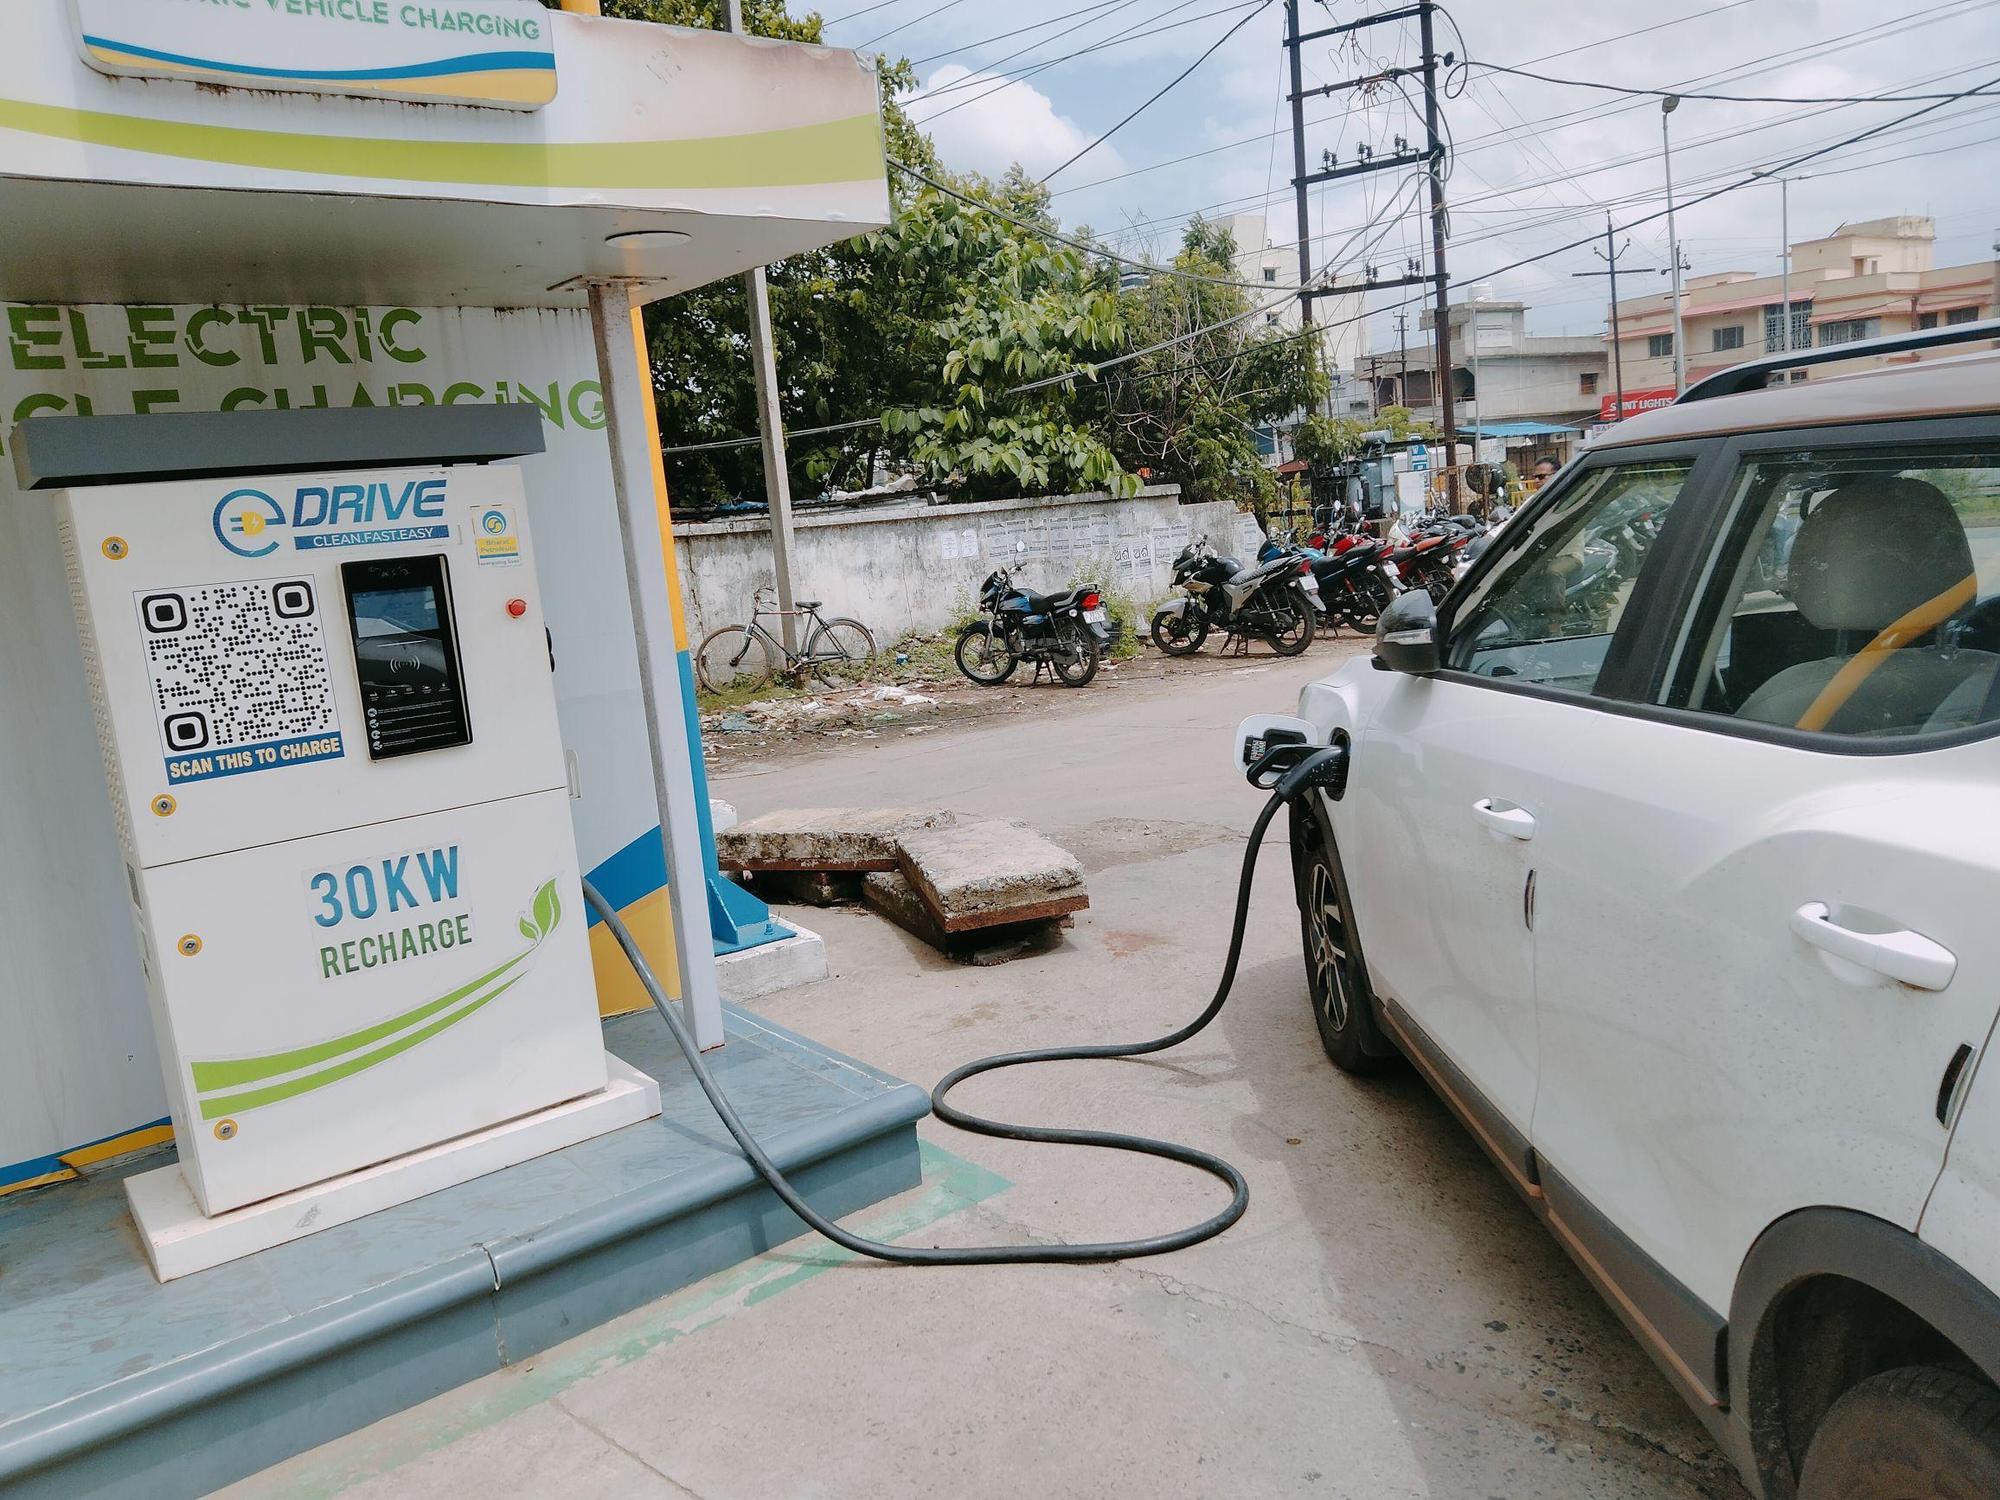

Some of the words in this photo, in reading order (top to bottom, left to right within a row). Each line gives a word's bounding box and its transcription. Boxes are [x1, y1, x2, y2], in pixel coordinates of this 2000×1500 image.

[401, 5, 540, 40] CHARGING
[7, 307, 427, 370] ELECTRIC
[1609, 400, 1638, 412] SINT
[1640, 397, 1673, 409] LIGHTS
[292, 479, 447, 528] DRIVE
[313, 527, 434, 548] CLEAN.FAST.EASY
[169, 757, 213, 778] SCAN
[216, 751, 253, 771] THIS
[255, 748, 277, 764] TO
[280, 737, 341, 759] CHARGE
[310, 845, 458, 928] 30KW
[320, 914, 473, 979] RECHARGE
